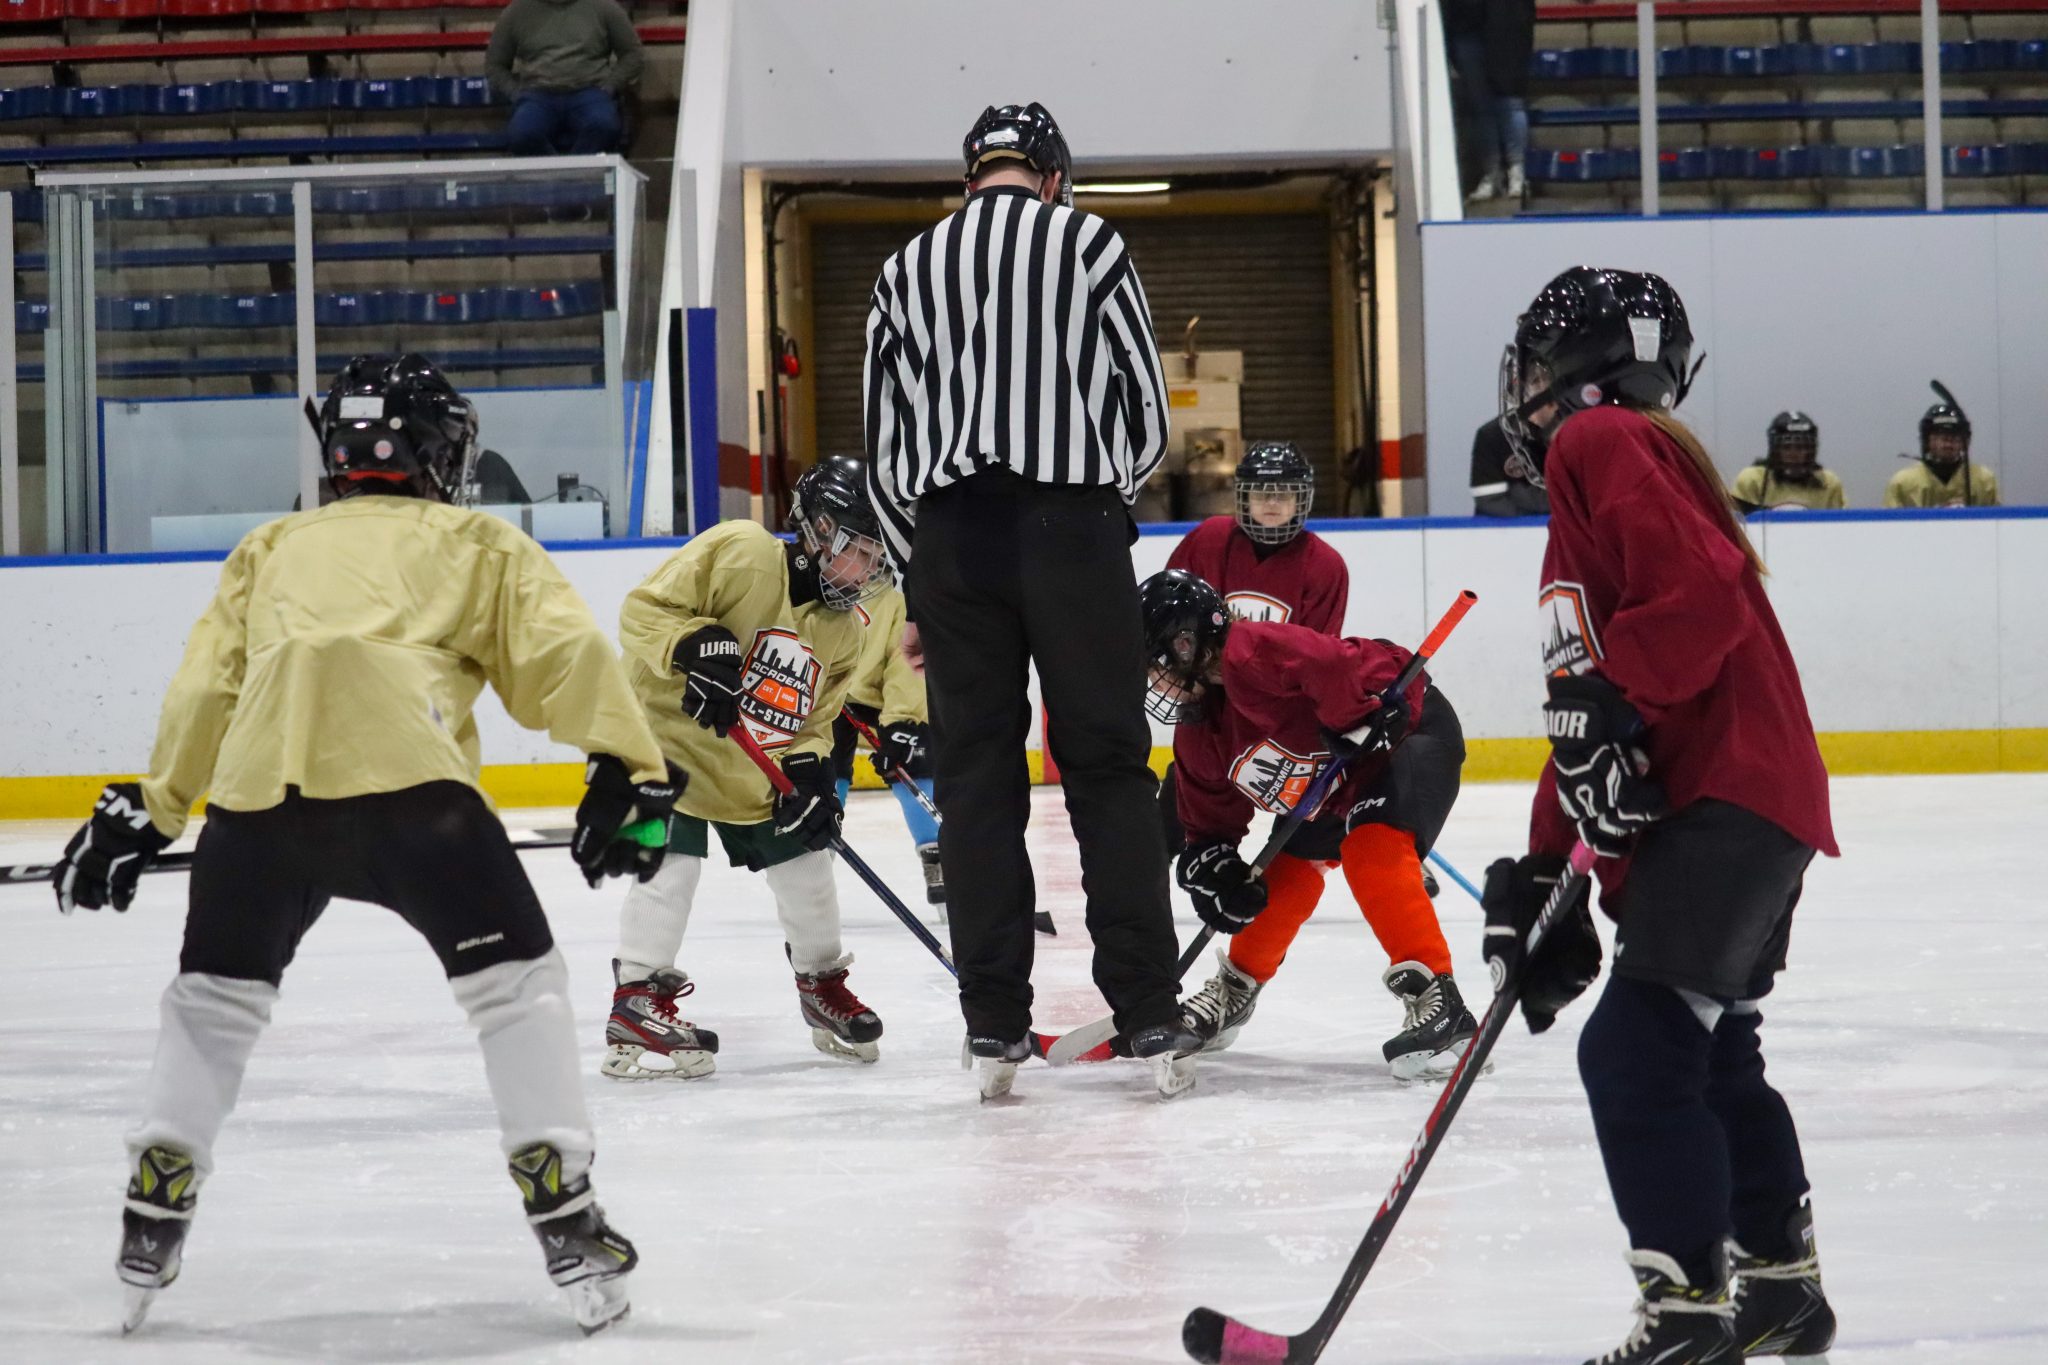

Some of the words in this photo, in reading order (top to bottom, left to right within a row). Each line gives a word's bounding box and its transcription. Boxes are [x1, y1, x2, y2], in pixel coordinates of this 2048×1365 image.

[740, 695, 804, 732] LL-STAR
[1389, 971, 1408, 988] CCM
[1434, 1017, 1450, 1032] CCM
[1386, 1124, 1427, 1211] CCM
